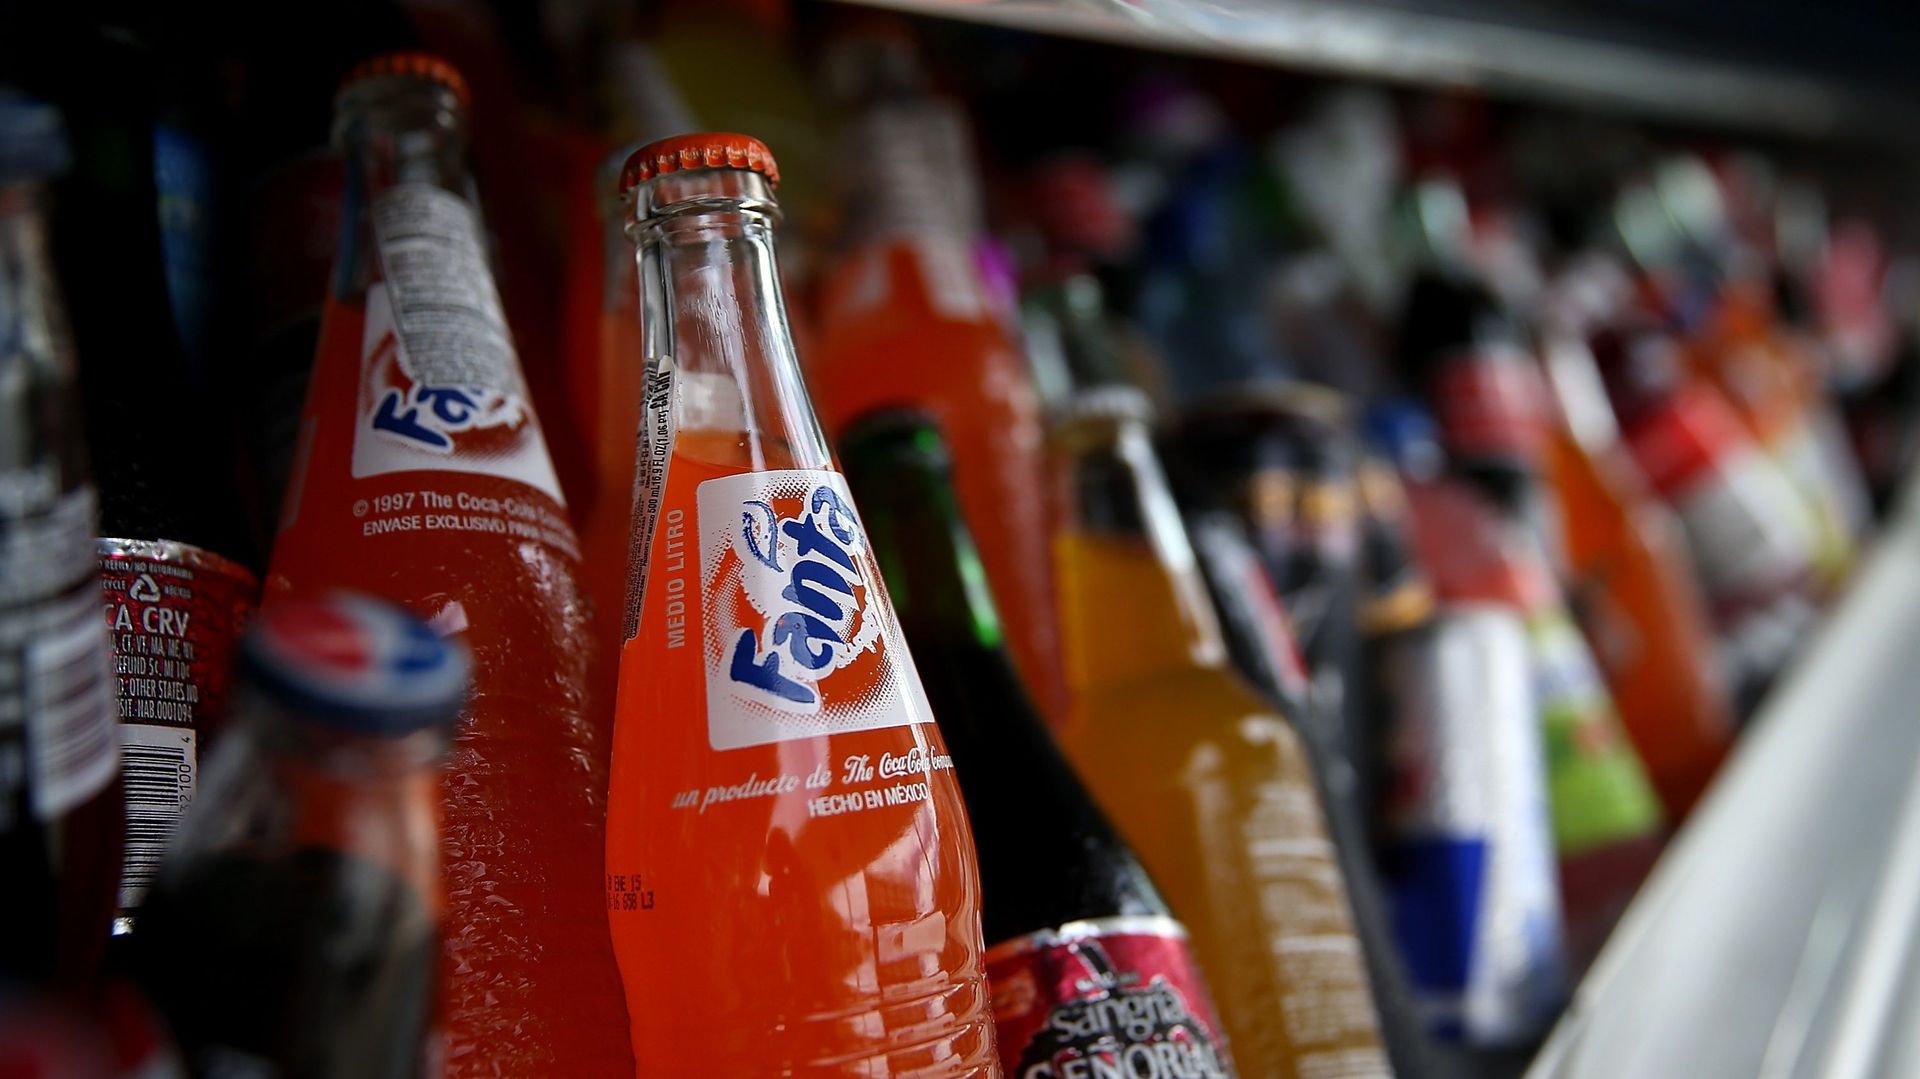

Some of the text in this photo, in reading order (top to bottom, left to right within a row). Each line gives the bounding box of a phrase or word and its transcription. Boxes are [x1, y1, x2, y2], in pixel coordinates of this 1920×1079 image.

[374, 492, 415, 513] 1997
[420, 491, 453, 509] The
[648, 499, 658, 513] 500
[653, 457, 665, 467] FL
[363, 515, 421, 536] ENVASE
[425, 514, 505, 533] EXCLUSIVO
[667, 508, 685, 649] MEDIO LITRO
[730, 485, 865, 704] Fanta
[143, 606, 189, 638] CRV
[113, 655, 146, 675] REFUND
[129, 678, 157, 698] OTHER
[158, 680, 185, 701] STATES
[672, 790, 699, 809] un
[699, 772, 800, 815] producto
[806, 763, 832, 789] de
[842, 754, 874, 785] The
[807, 782, 928, 818] HECHO EN MÉXICO
